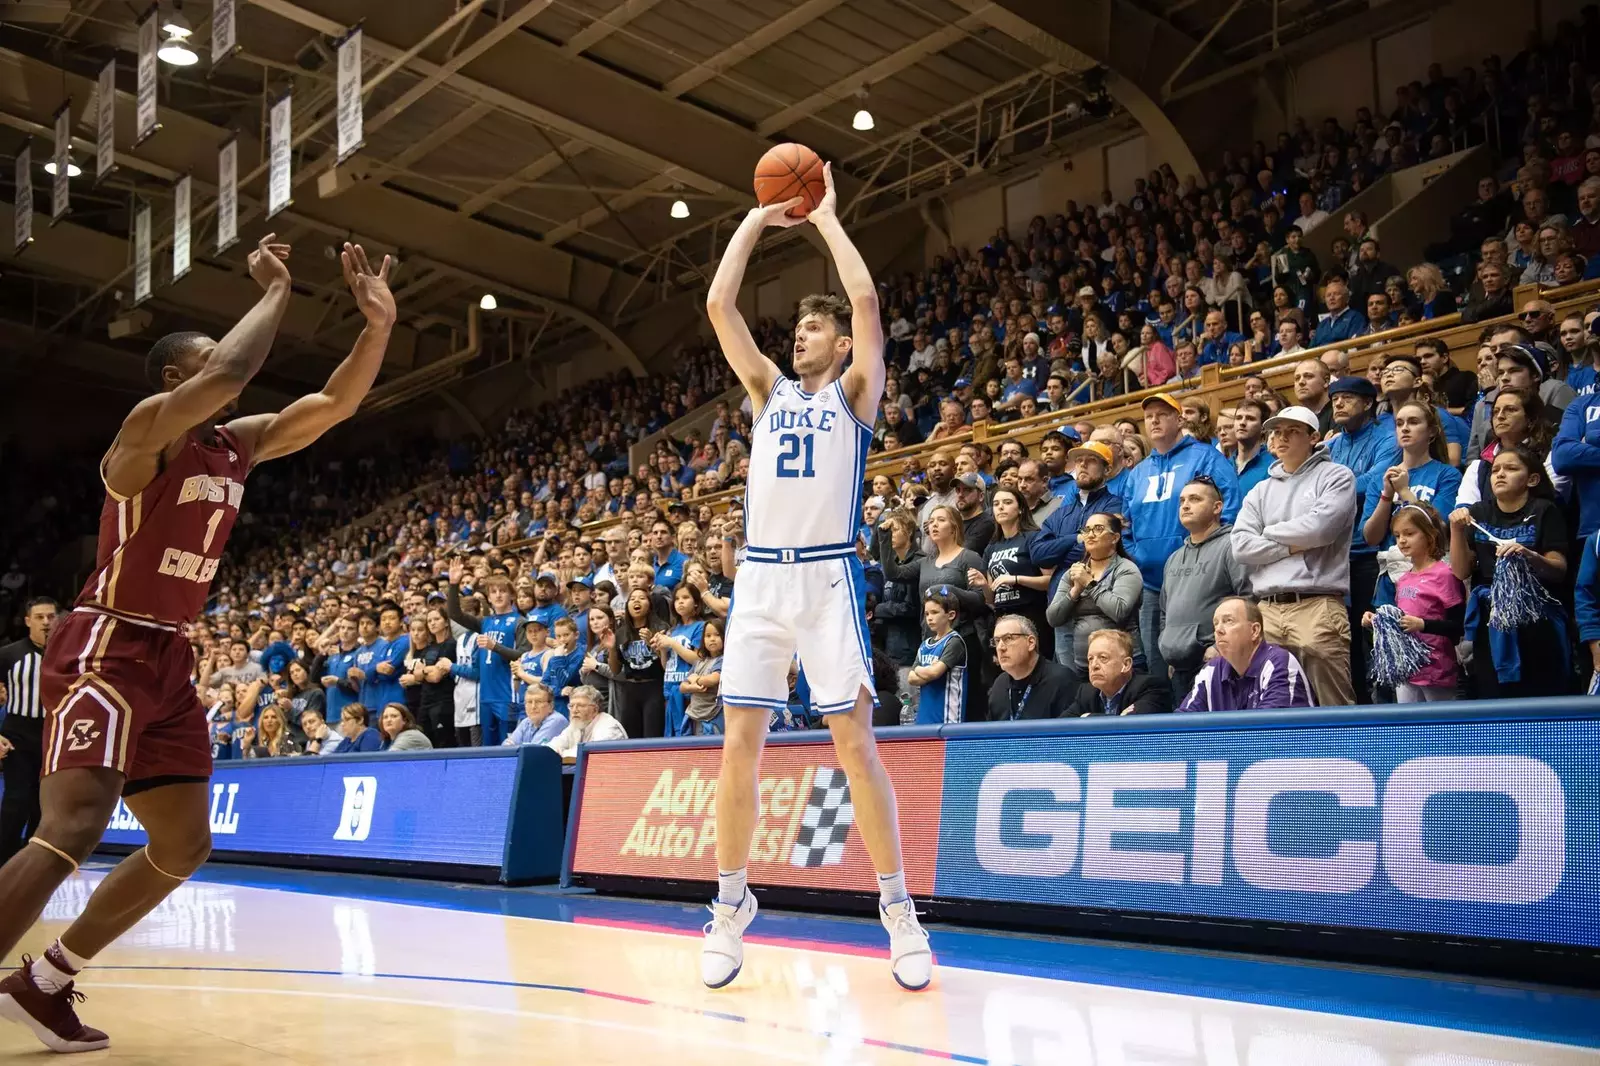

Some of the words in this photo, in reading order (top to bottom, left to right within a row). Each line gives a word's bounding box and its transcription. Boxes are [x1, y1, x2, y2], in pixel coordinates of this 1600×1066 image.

[769, 407, 836, 434] DUKE
[776, 433, 816, 478] 21
[177, 474, 244, 513] BOST
[1393, 485, 1435, 502] KE
[203, 509, 225, 554] 1
[641, 767, 796, 818] Advce
[619, 816, 695, 858] Auto
[694, 818, 783, 863] Pts
[974, 754, 1566, 905] GEICO
